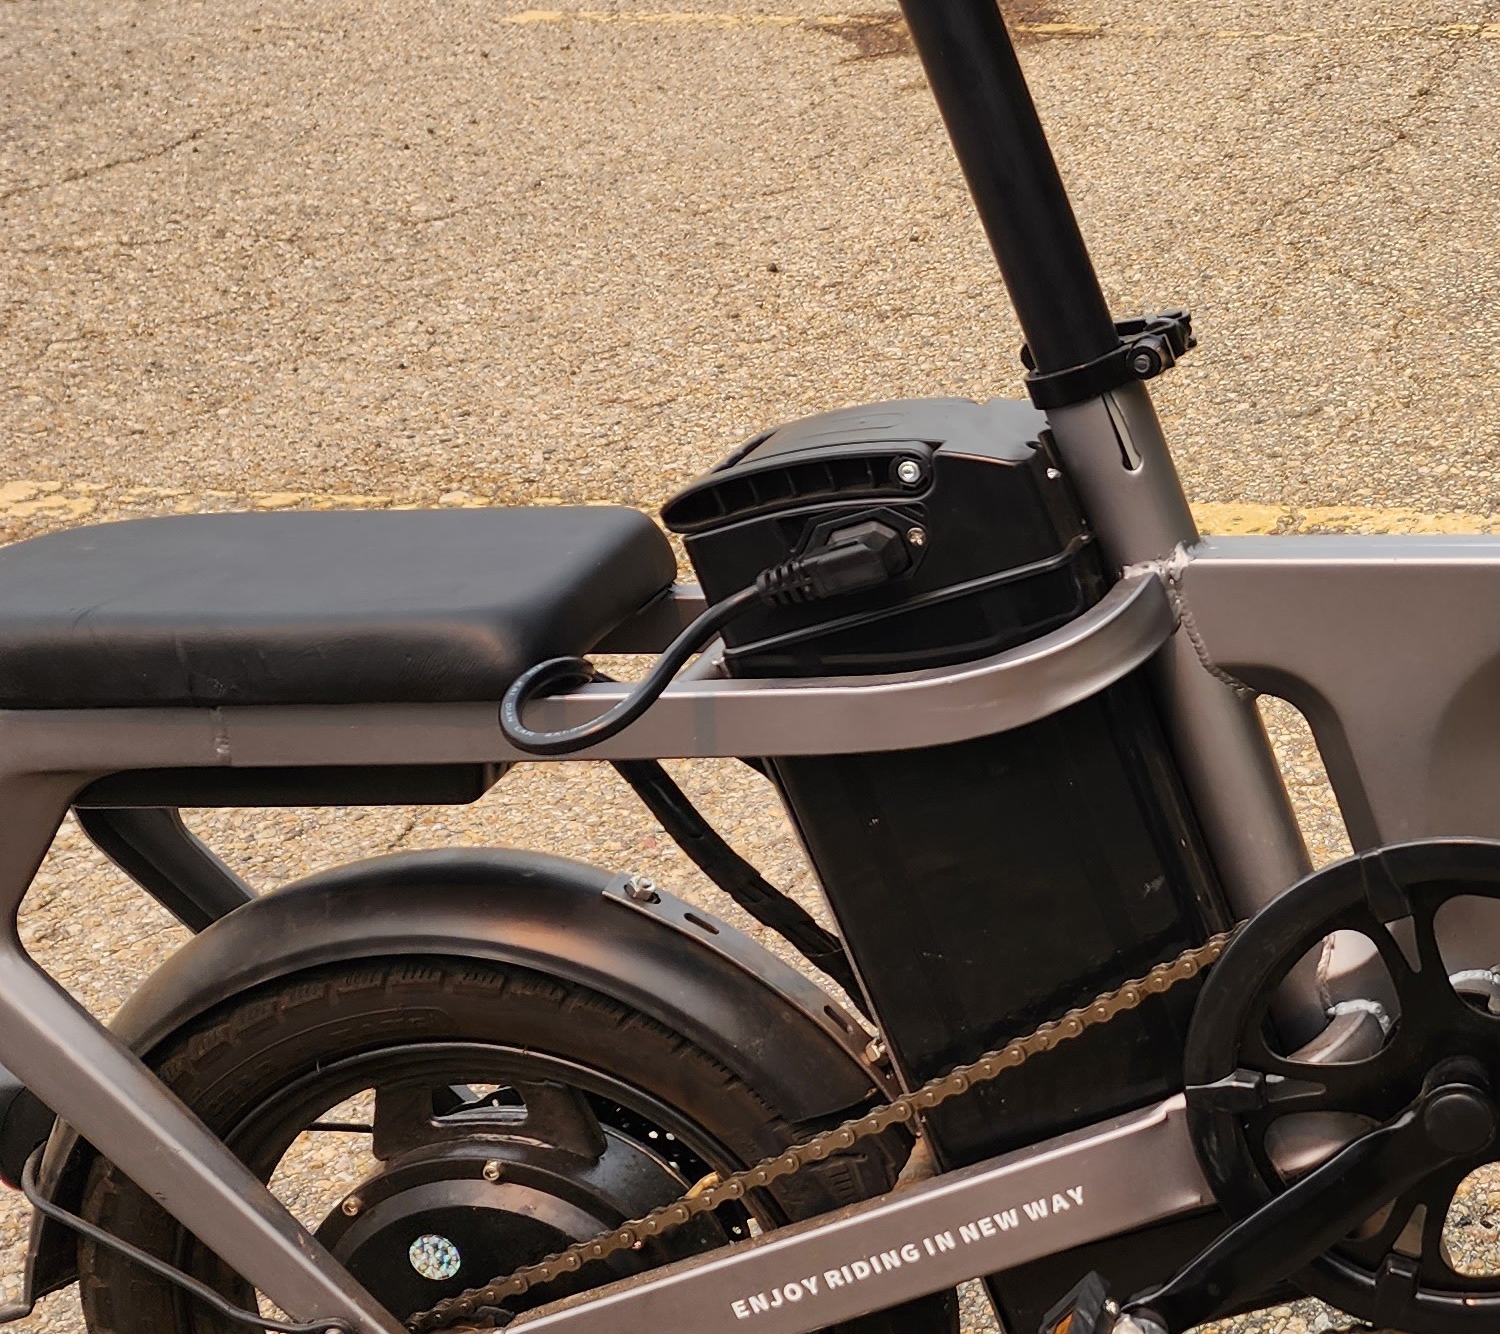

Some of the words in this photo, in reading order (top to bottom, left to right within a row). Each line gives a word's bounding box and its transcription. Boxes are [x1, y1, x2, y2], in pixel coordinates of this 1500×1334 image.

[730, 1275, 818, 1320] ENJOY
[823, 1243, 921, 1290] RIDING
[922, 1230, 957, 1257] IN
[958, 1208, 1020, 1245] NEW
[1022, 1185, 1084, 1222] WAY
